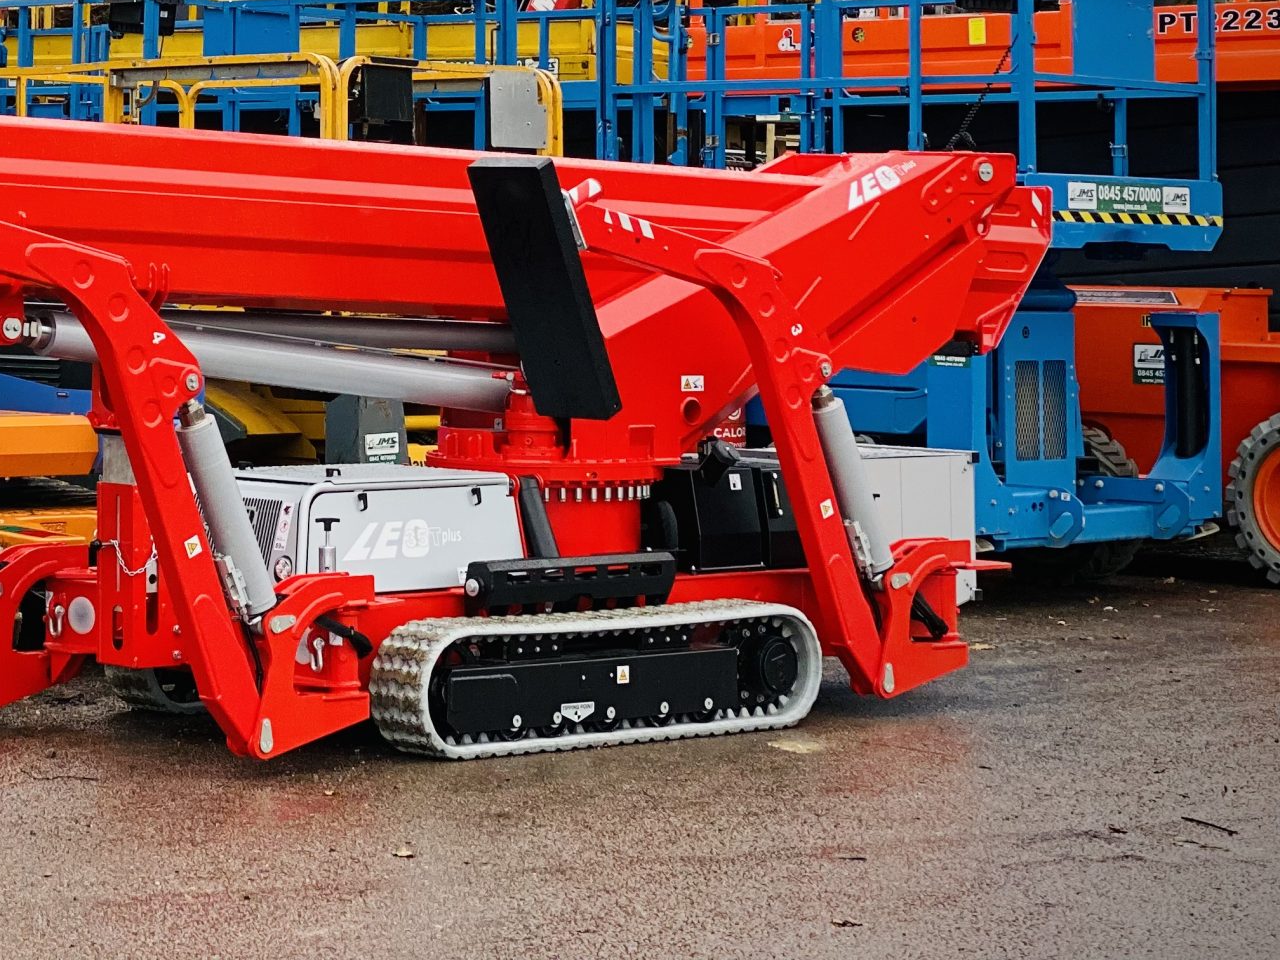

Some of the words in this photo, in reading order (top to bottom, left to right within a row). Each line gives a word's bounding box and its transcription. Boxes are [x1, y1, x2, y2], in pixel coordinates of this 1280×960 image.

[1157, 8, 1280, 35] PT223
[847, 165, 901, 211] LEO
[1077, 189, 1095, 198] JMS
[1098, 185, 1121, 201] 0845
[1122, 186, 1161, 202] 4570000
[1172, 193, 1188, 202] JMS
[152, 331, 166, 345] 4
[376, 436, 397, 446] JMS
[342, 519, 431, 561] LEO
[441, 529, 462, 545] plus
